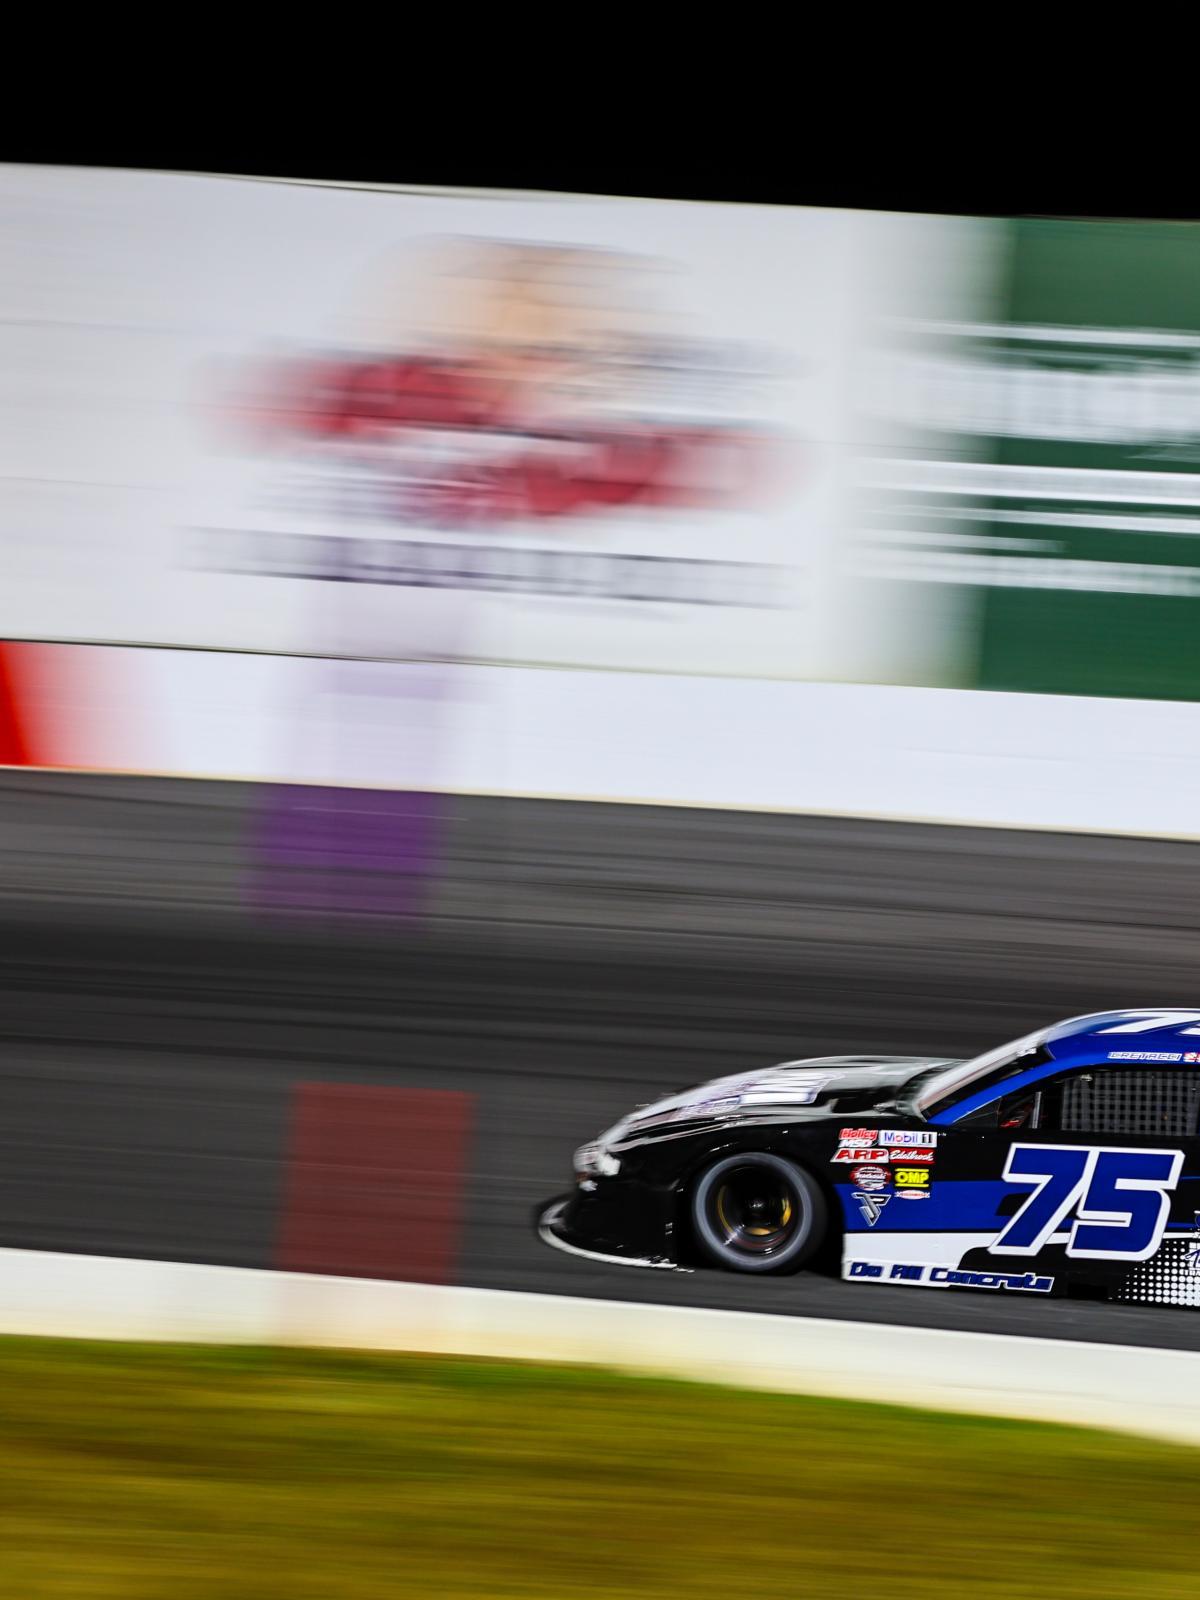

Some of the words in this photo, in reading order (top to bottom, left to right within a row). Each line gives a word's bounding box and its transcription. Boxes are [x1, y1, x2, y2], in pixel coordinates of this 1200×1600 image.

[839, 1128, 878, 1141] Holley
[884, 1131, 918, 1143] Mobil
[835, 1149, 886, 1160] ARP
[889, 1149, 935, 1162] Edelbrock
[894, 1171, 930, 1184] OMP
[987, 1142, 1186, 1262] 75
[850, 1261, 884, 1278] Do
